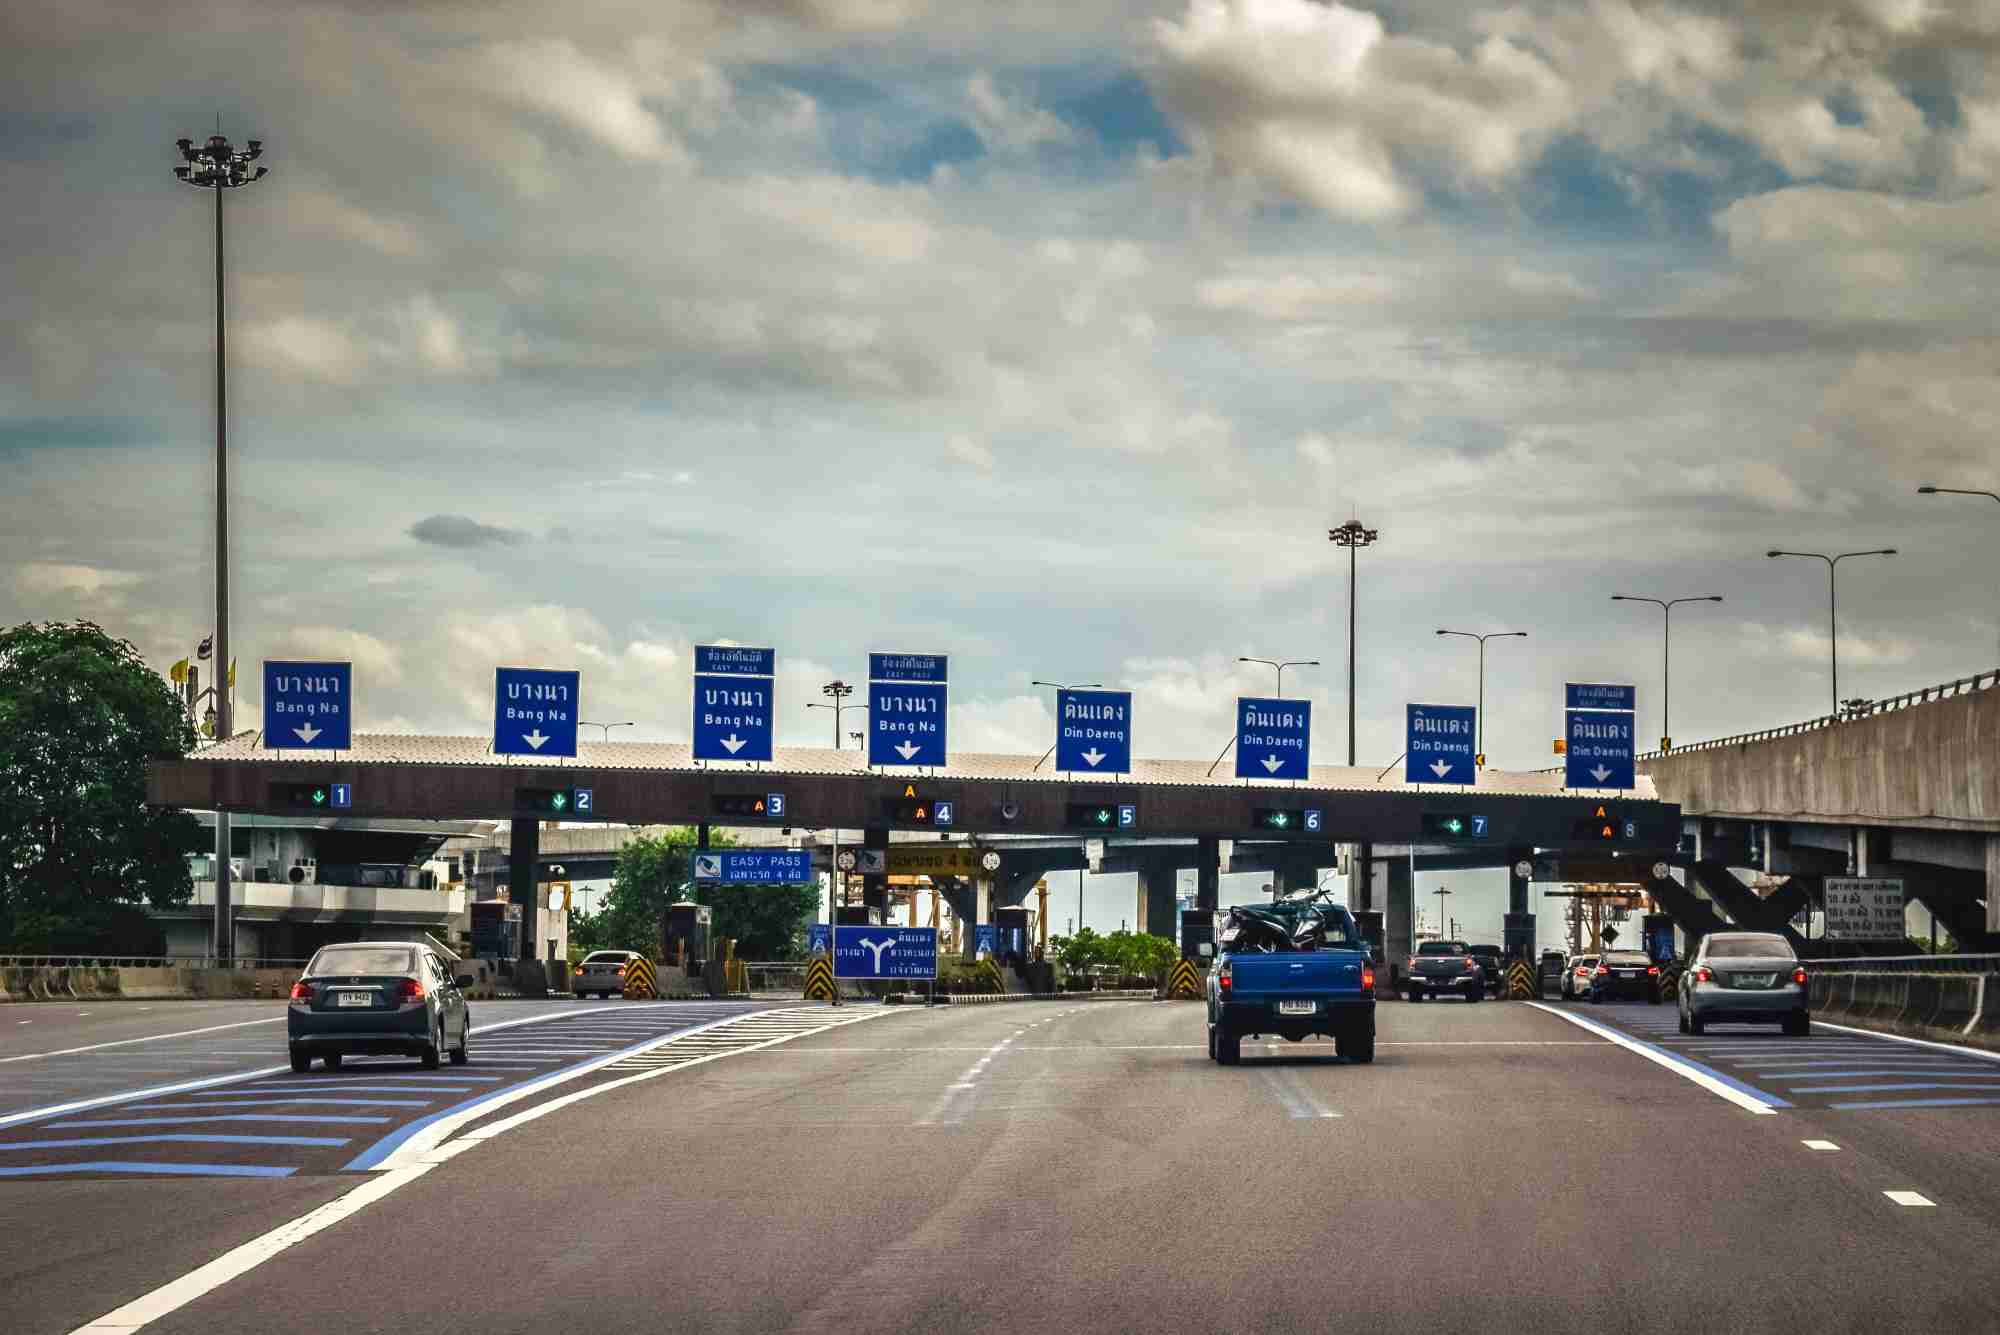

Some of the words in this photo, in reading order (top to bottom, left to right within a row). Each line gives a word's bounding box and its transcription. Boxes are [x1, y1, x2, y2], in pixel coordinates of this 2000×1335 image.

[275, 676, 339, 693] บางนา
[507, 683, 568, 700] บางนา
[705, 689, 763, 707] บางนา
[880, 697, 937, 713] บางนา
[275, 701, 315, 716] Bang
[320, 702, 339, 713] Na
[507, 707, 544, 722] Bang
[549, 709, 567, 721] Na
[1065, 696, 1124, 720] ดินแดง
[704, 714, 740, 728] Bang
[745, 715, 762, 726] Na
[1245, 705, 1303, 728] ดินแดง
[1414, 710, 1469, 734] ดินแดง
[879, 720, 915, 734] Bang
[919, 721, 936, 732] Na
[1064, 726, 1083, 738] Din
[1086, 728, 1124, 742] Daeng
[1573, 716, 1629, 739] ดินแดง
[1244, 733, 1262, 745] Din
[1266, 736, 1303, 750] Daeng
[1412, 739, 1431, 751] Din
[1434, 741, 1469, 754] Daeng
[1572, 745, 1592, 757] Din
[1593, 746, 1629, 758] Daeng
[337, 787, 345, 804] 1
[904, 785, 916, 798] A
[577, 793, 590, 809] 2
[754, 800, 764, 811] A
[771, 797, 782, 813] 3
[916, 808, 925, 818] A
[937, 805, 950, 821] 4
[1121, 809, 1133, 824] 5
[1307, 813, 1318, 829] 6
[1474, 819, 1484, 833] 7
[1626, 823, 1634, 838] 8
[730, 856, 762, 866] EASY
[770, 856, 801, 866] PASS
[776, 871, 783, 879] 4
[836, 948, 865, 957] บางนา
